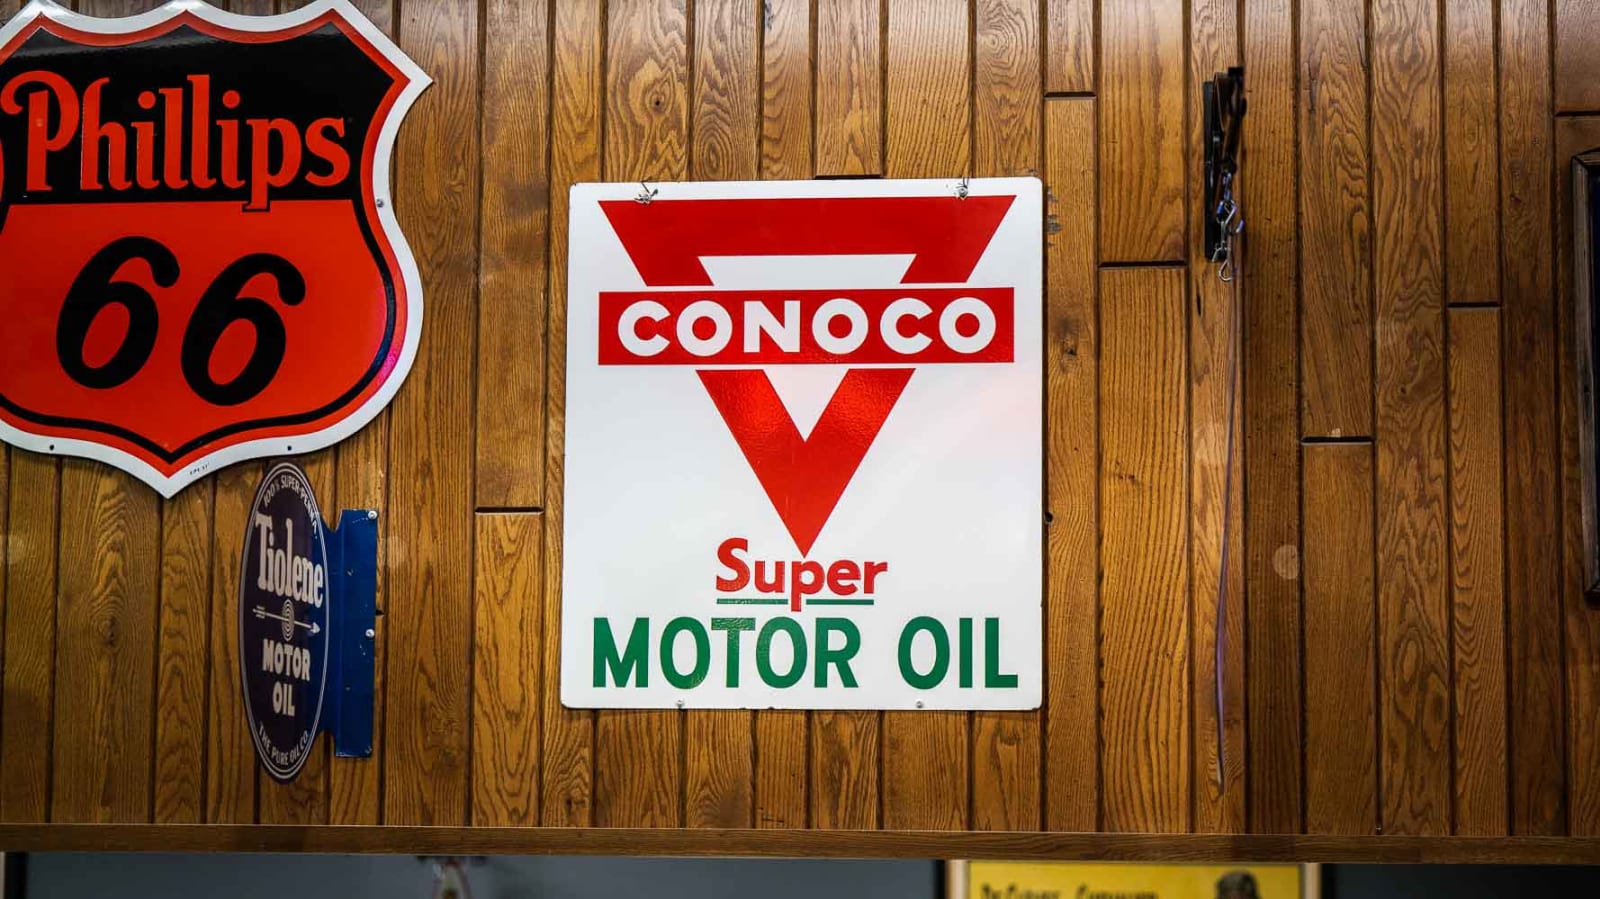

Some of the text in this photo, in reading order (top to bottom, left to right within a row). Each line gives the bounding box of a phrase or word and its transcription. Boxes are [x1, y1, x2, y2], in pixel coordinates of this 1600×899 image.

[1, 70, 351, 212] Phillips
[56, 236, 306, 406] 66
[617, 296, 997, 357] CONOCO
[255, 512, 323, 608] Tiolene
[715, 537, 888, 612] Super
[262, 637, 310, 681] MOTOR
[592, 615, 1019, 690] MOTOR OIL
[272, 681, 295, 717] OIL
[259, 721, 272, 755] THE
[271, 745, 289, 766] PURE
[289, 743, 301, 764] OIL
